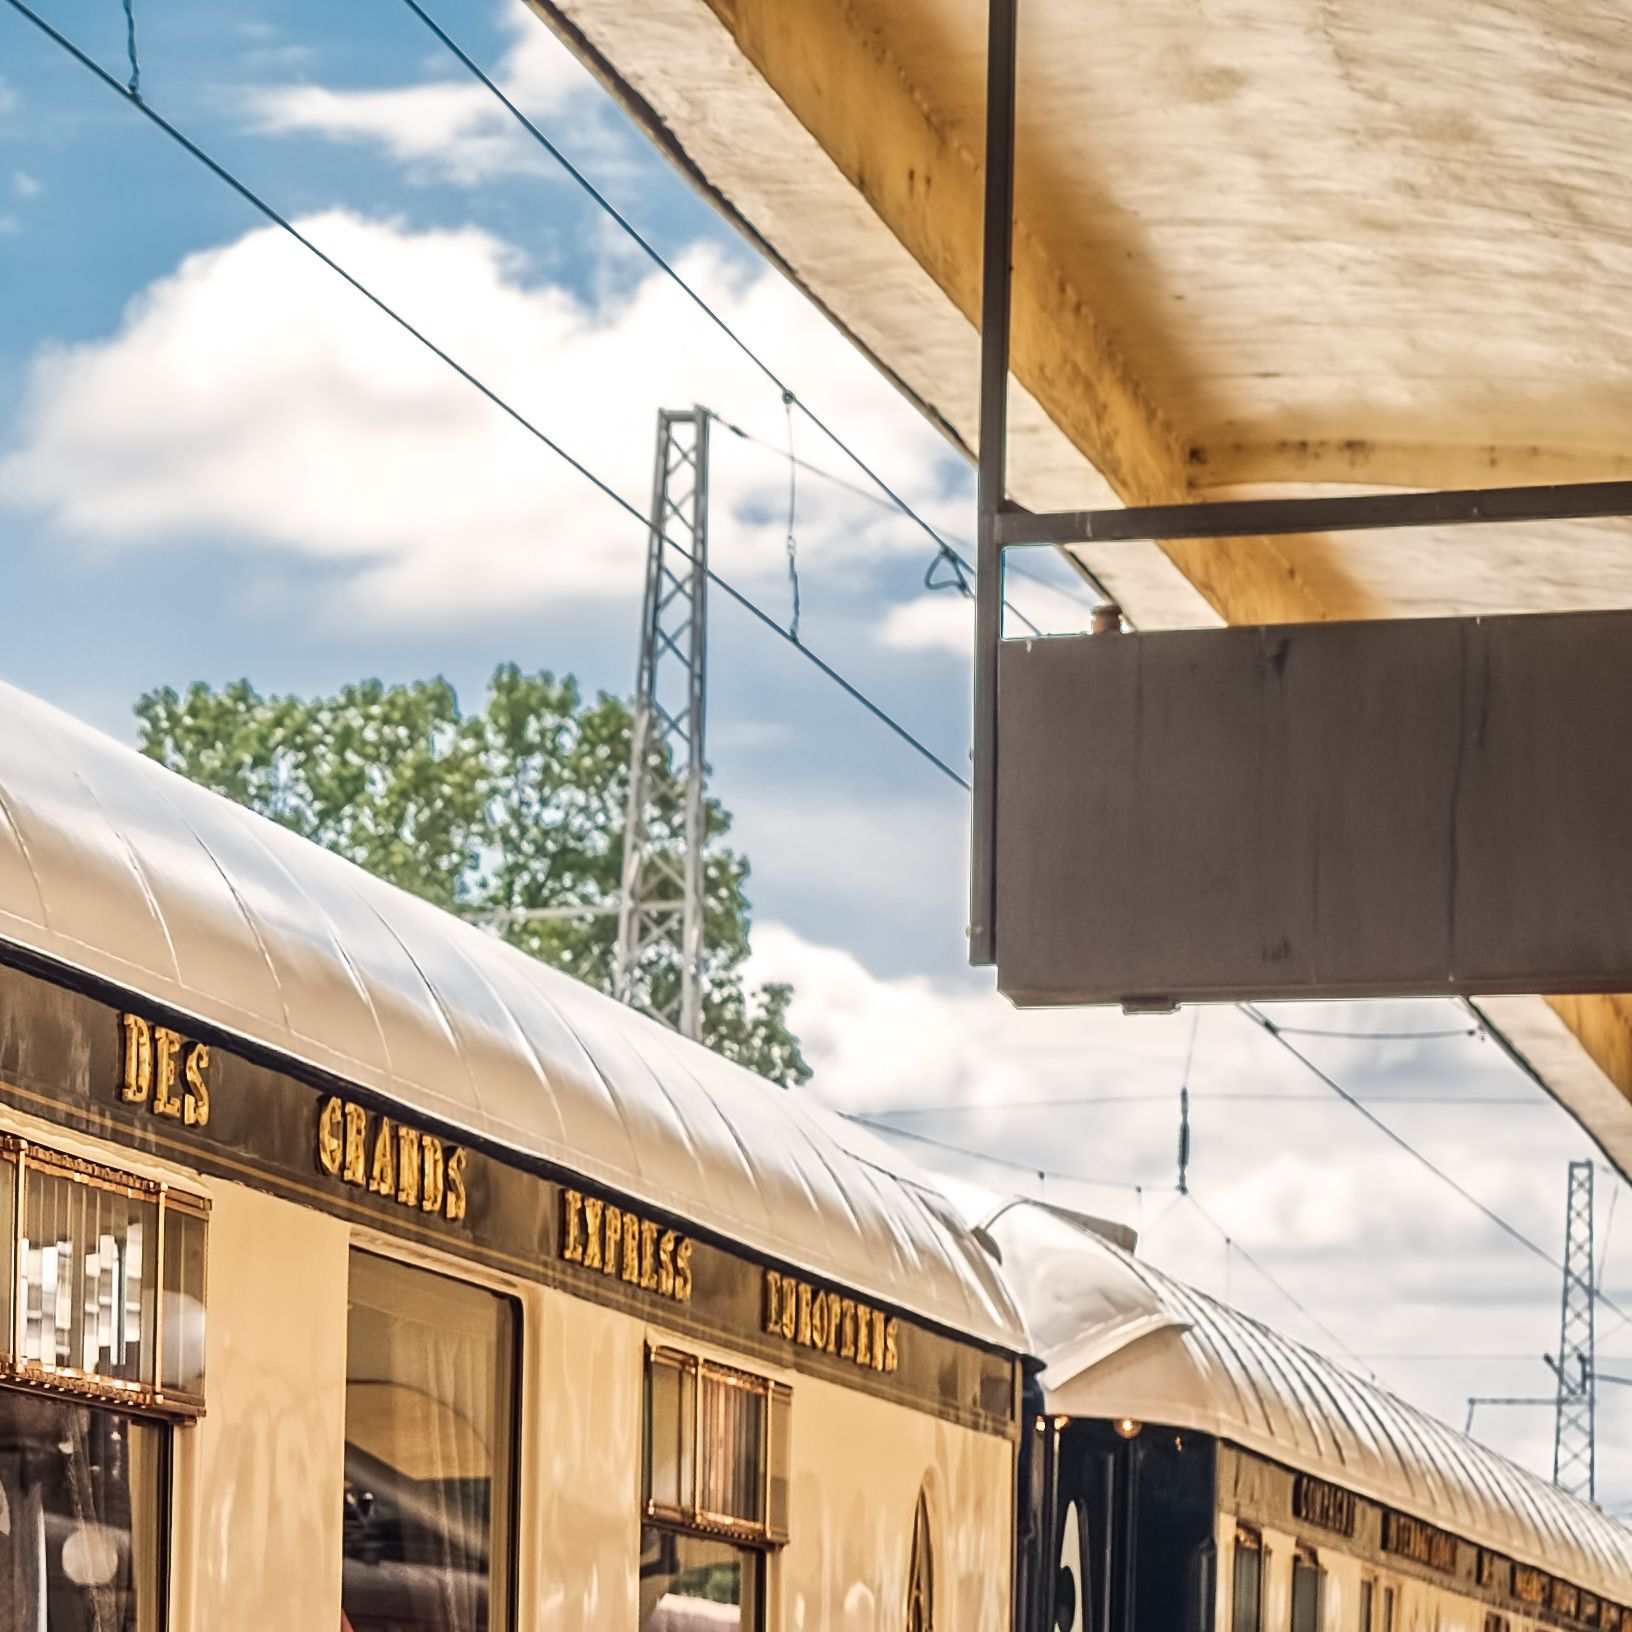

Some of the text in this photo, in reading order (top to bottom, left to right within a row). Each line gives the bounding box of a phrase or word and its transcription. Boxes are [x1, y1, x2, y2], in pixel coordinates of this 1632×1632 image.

[122, 1012, 210, 1126] DES
[319, 1097, 468, 1220] GRANDS
[563, 1188, 692, 1301] EXPRESS
